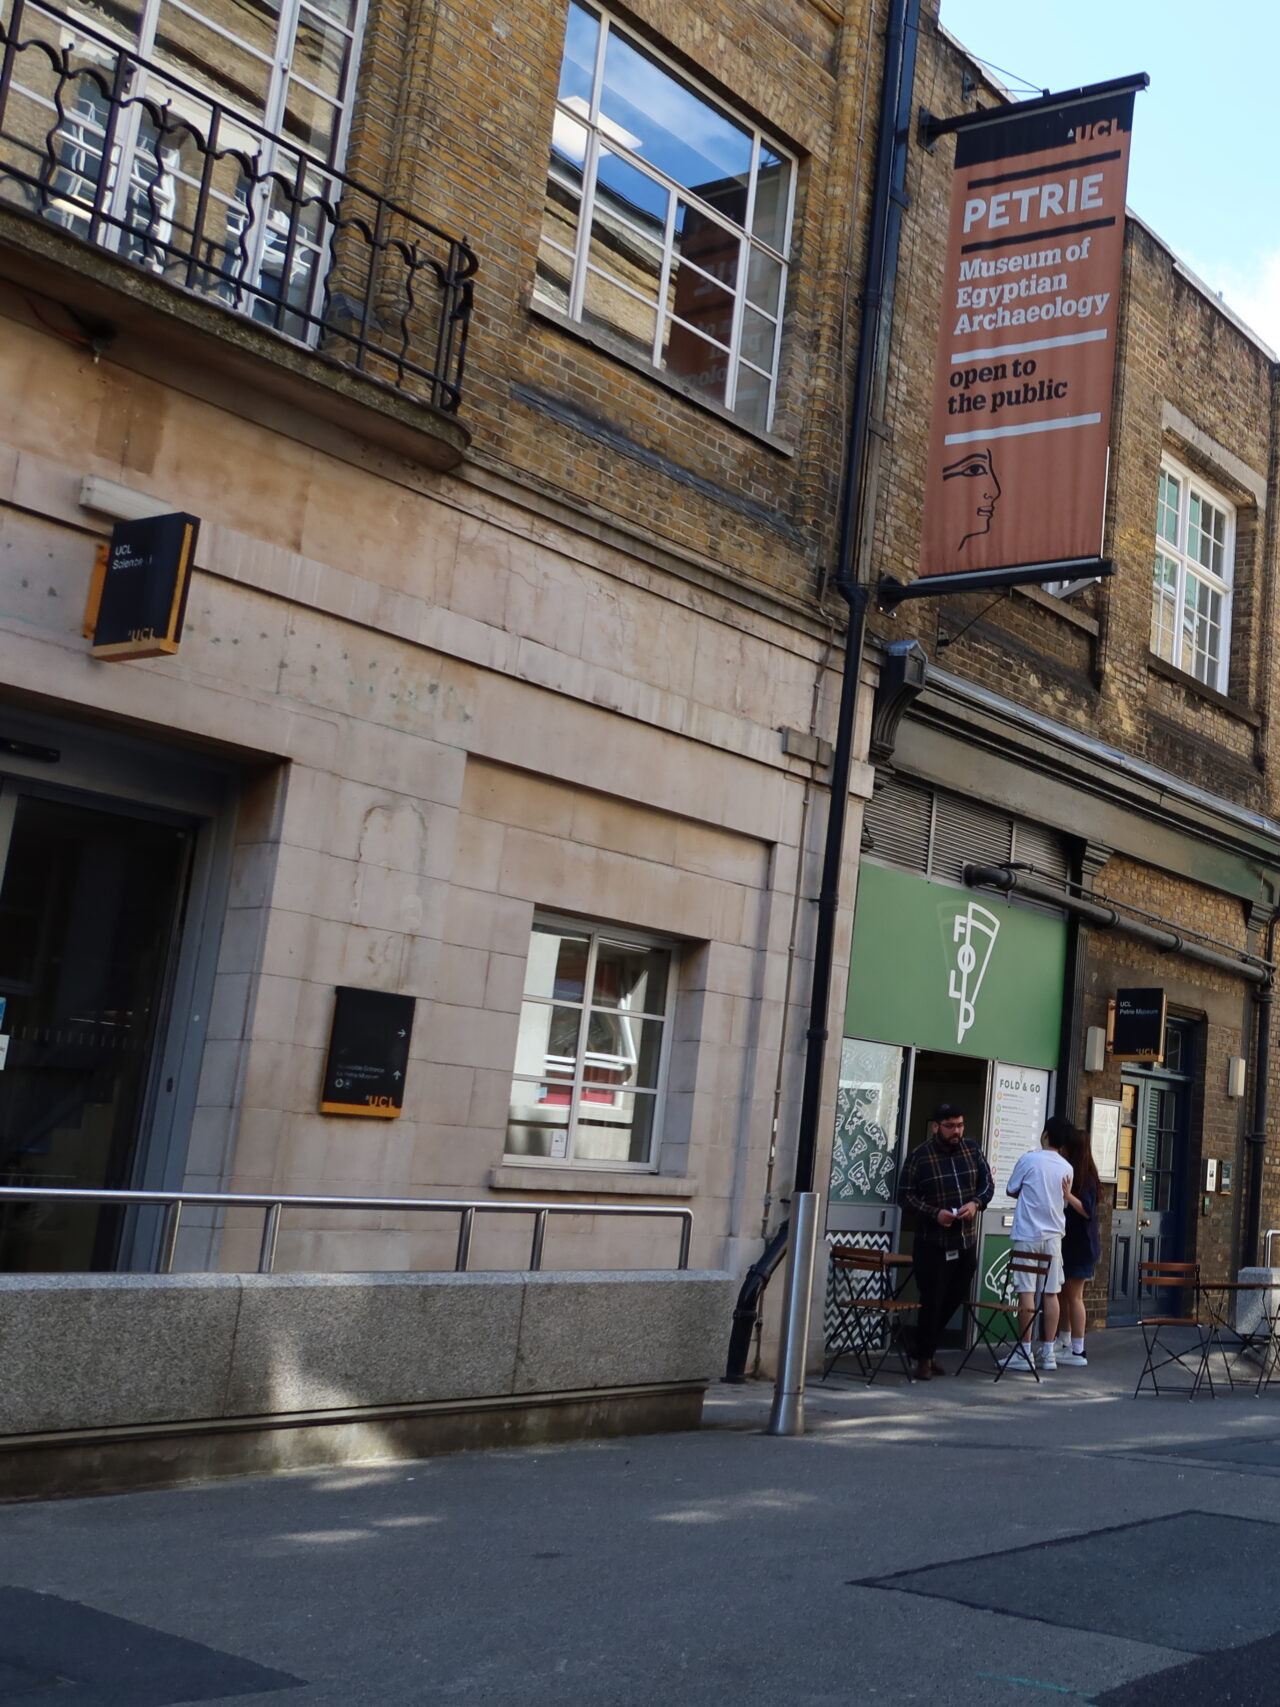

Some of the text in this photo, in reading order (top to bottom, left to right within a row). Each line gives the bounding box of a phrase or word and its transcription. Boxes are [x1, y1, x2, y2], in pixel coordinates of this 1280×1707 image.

[1074, 118, 1124, 143] UCL
[963, 173, 1103, 233] PETRIE
[958, 237, 1092, 282] Museum of
[956, 272, 1067, 309] Egyptian
[953, 293, 1110, 335] Archaeology
[949, 358, 1037, 390] open to
[947, 379, 1068, 415] the public
[115, 544, 132, 556] UCL
[132, 628, 155, 641] UCL
[1138, 1048, 1154, 1056] UCL
[1000, 1079, 1041, 1094] FOLD & GO
[369, 1095, 395, 1108] UCL
